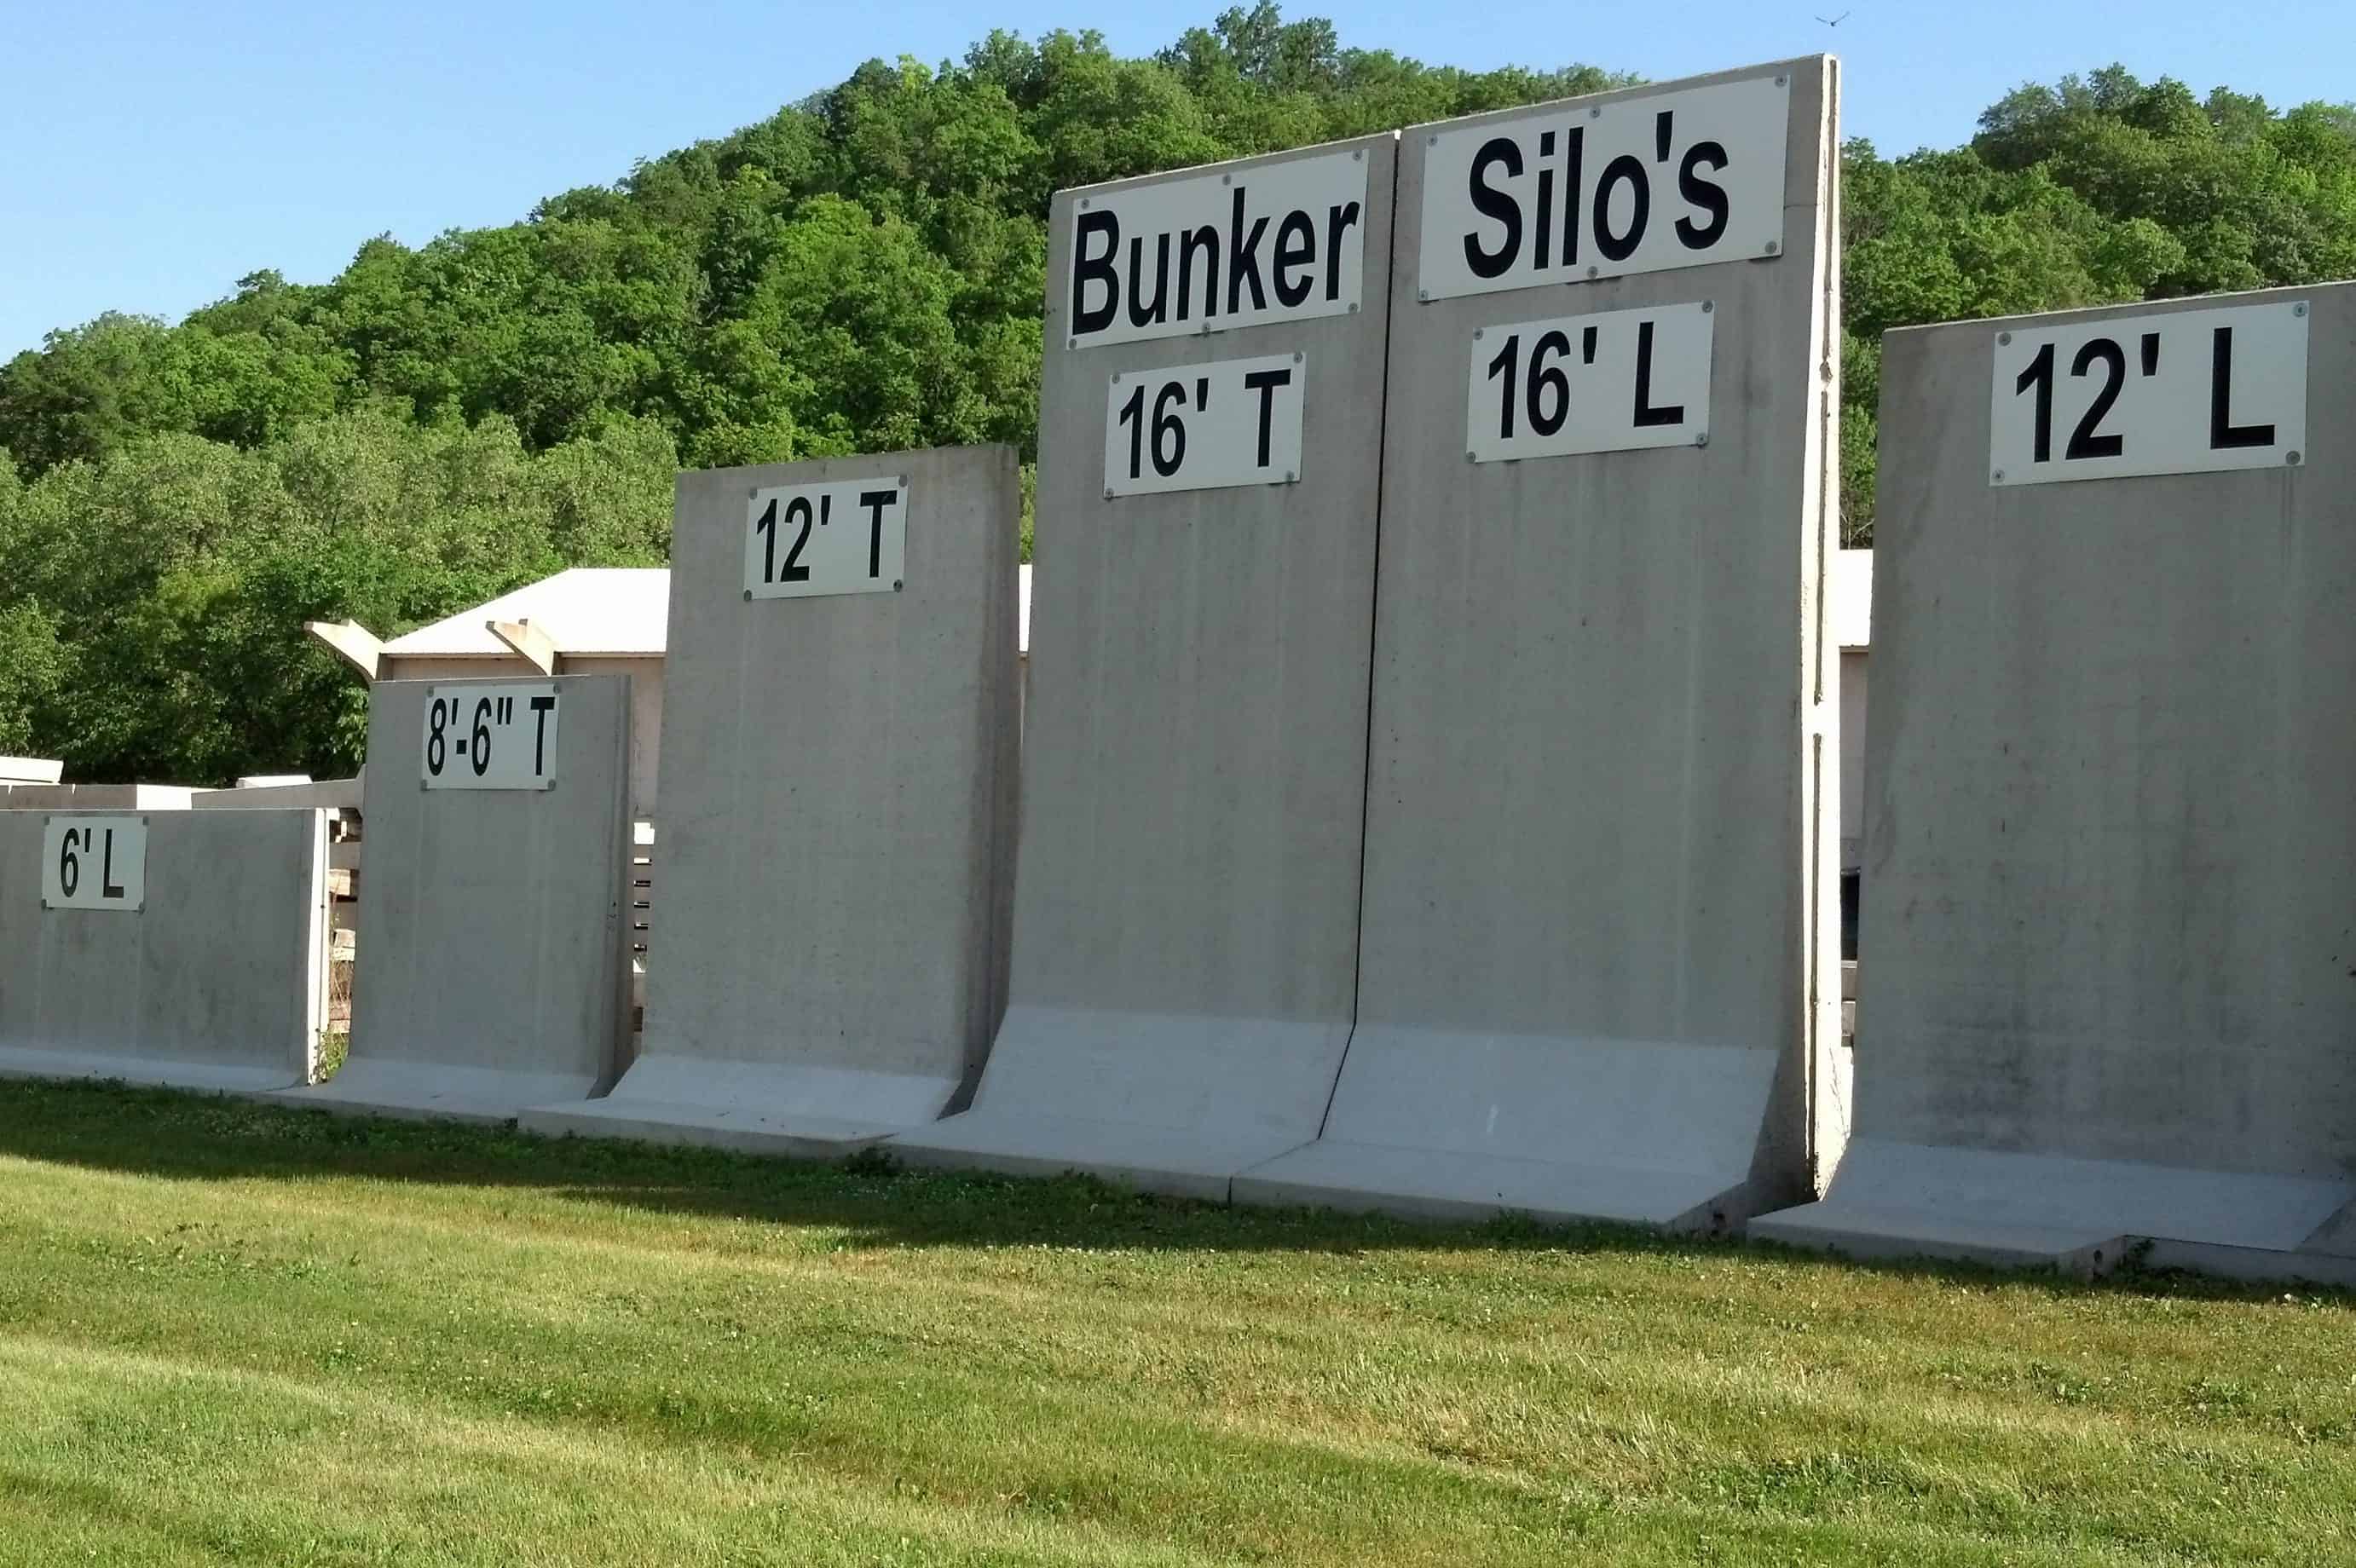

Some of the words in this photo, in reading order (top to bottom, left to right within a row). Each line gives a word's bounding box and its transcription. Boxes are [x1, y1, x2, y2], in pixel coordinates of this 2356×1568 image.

[1463, 109, 1729, 280] Silo's
[1071, 185, 1360, 337] Bunker
[1118, 377, 1210, 480] 16'
[1244, 367, 1292, 469] T
[1487, 326, 1599, 440] 16'
[1632, 320, 1685, 429] L
[2015, 331, 2161, 464] 12'
[2209, 326, 2277, 451] L
[755, 493, 832, 585] 12'
[858, 488, 898, 579] T
[529, 695, 557, 777] T
